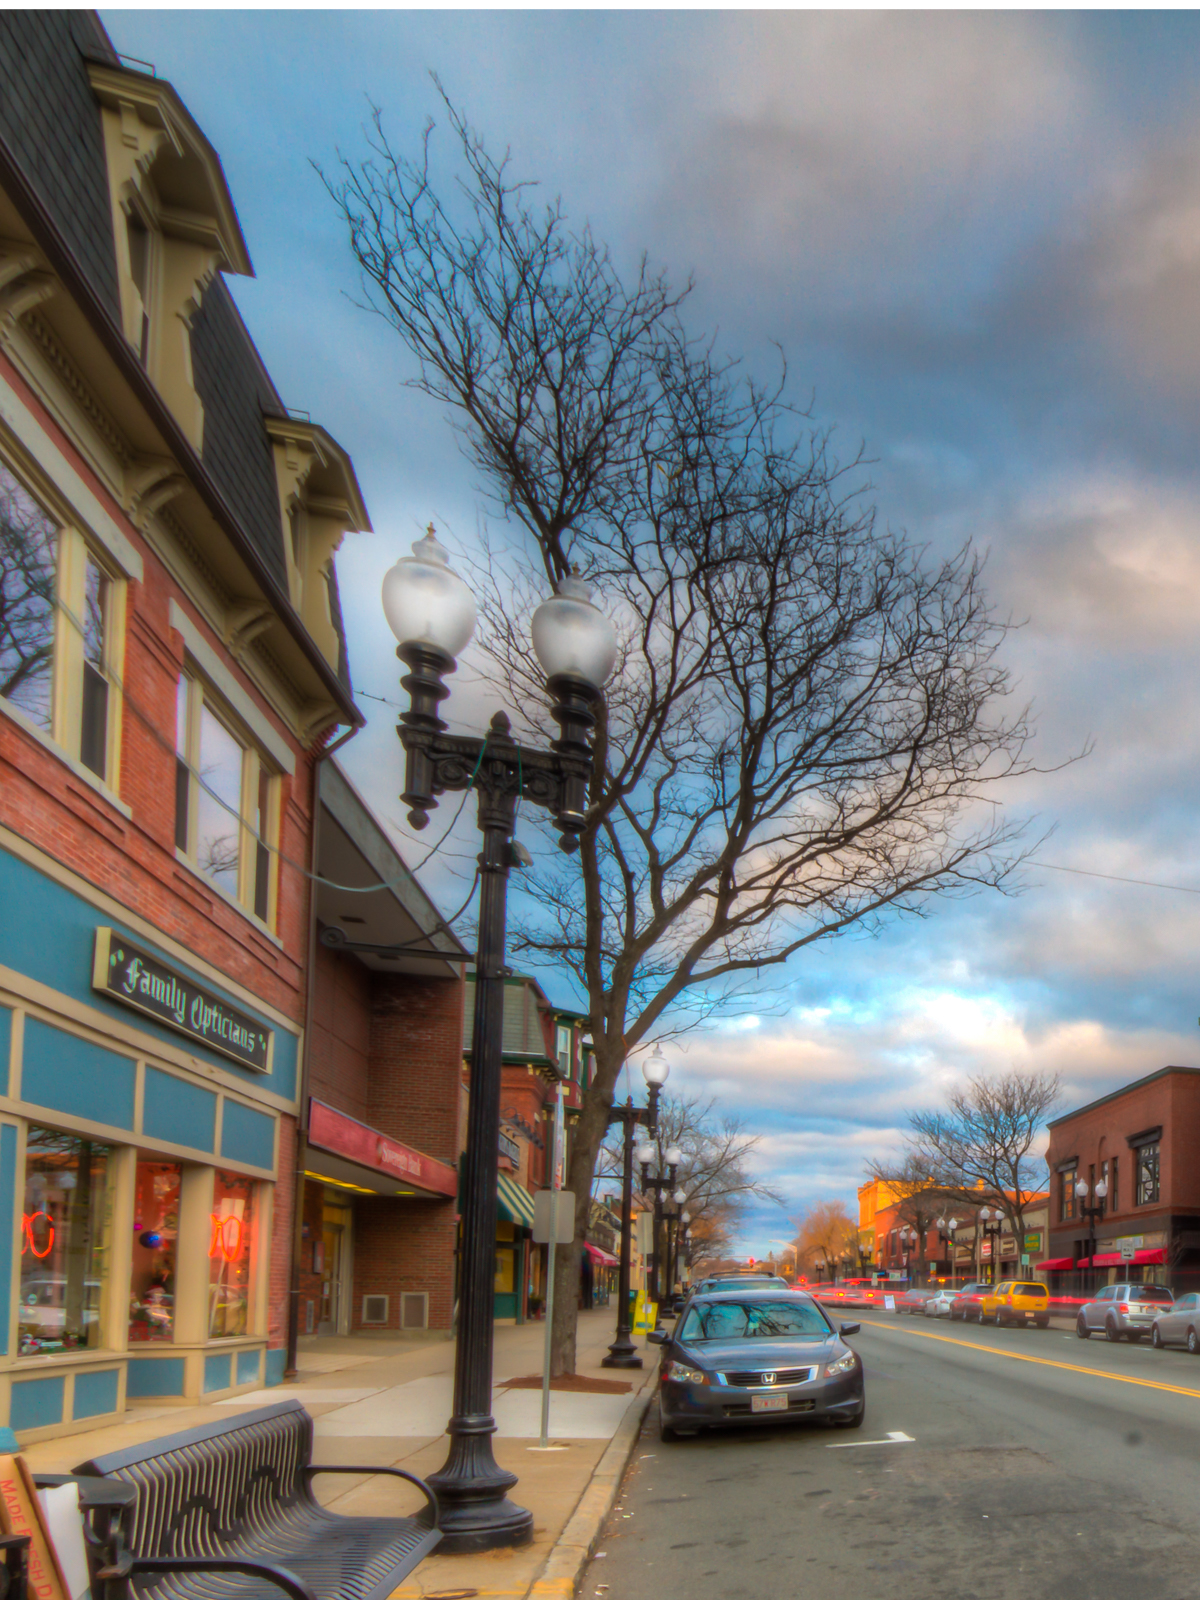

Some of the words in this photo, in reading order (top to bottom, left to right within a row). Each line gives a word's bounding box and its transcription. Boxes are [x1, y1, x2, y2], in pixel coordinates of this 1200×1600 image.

[122, 957, 187, 1024] Family
[190, 994, 256, 1053] Opticians
[0, 1478, 26, 1526] MADE
